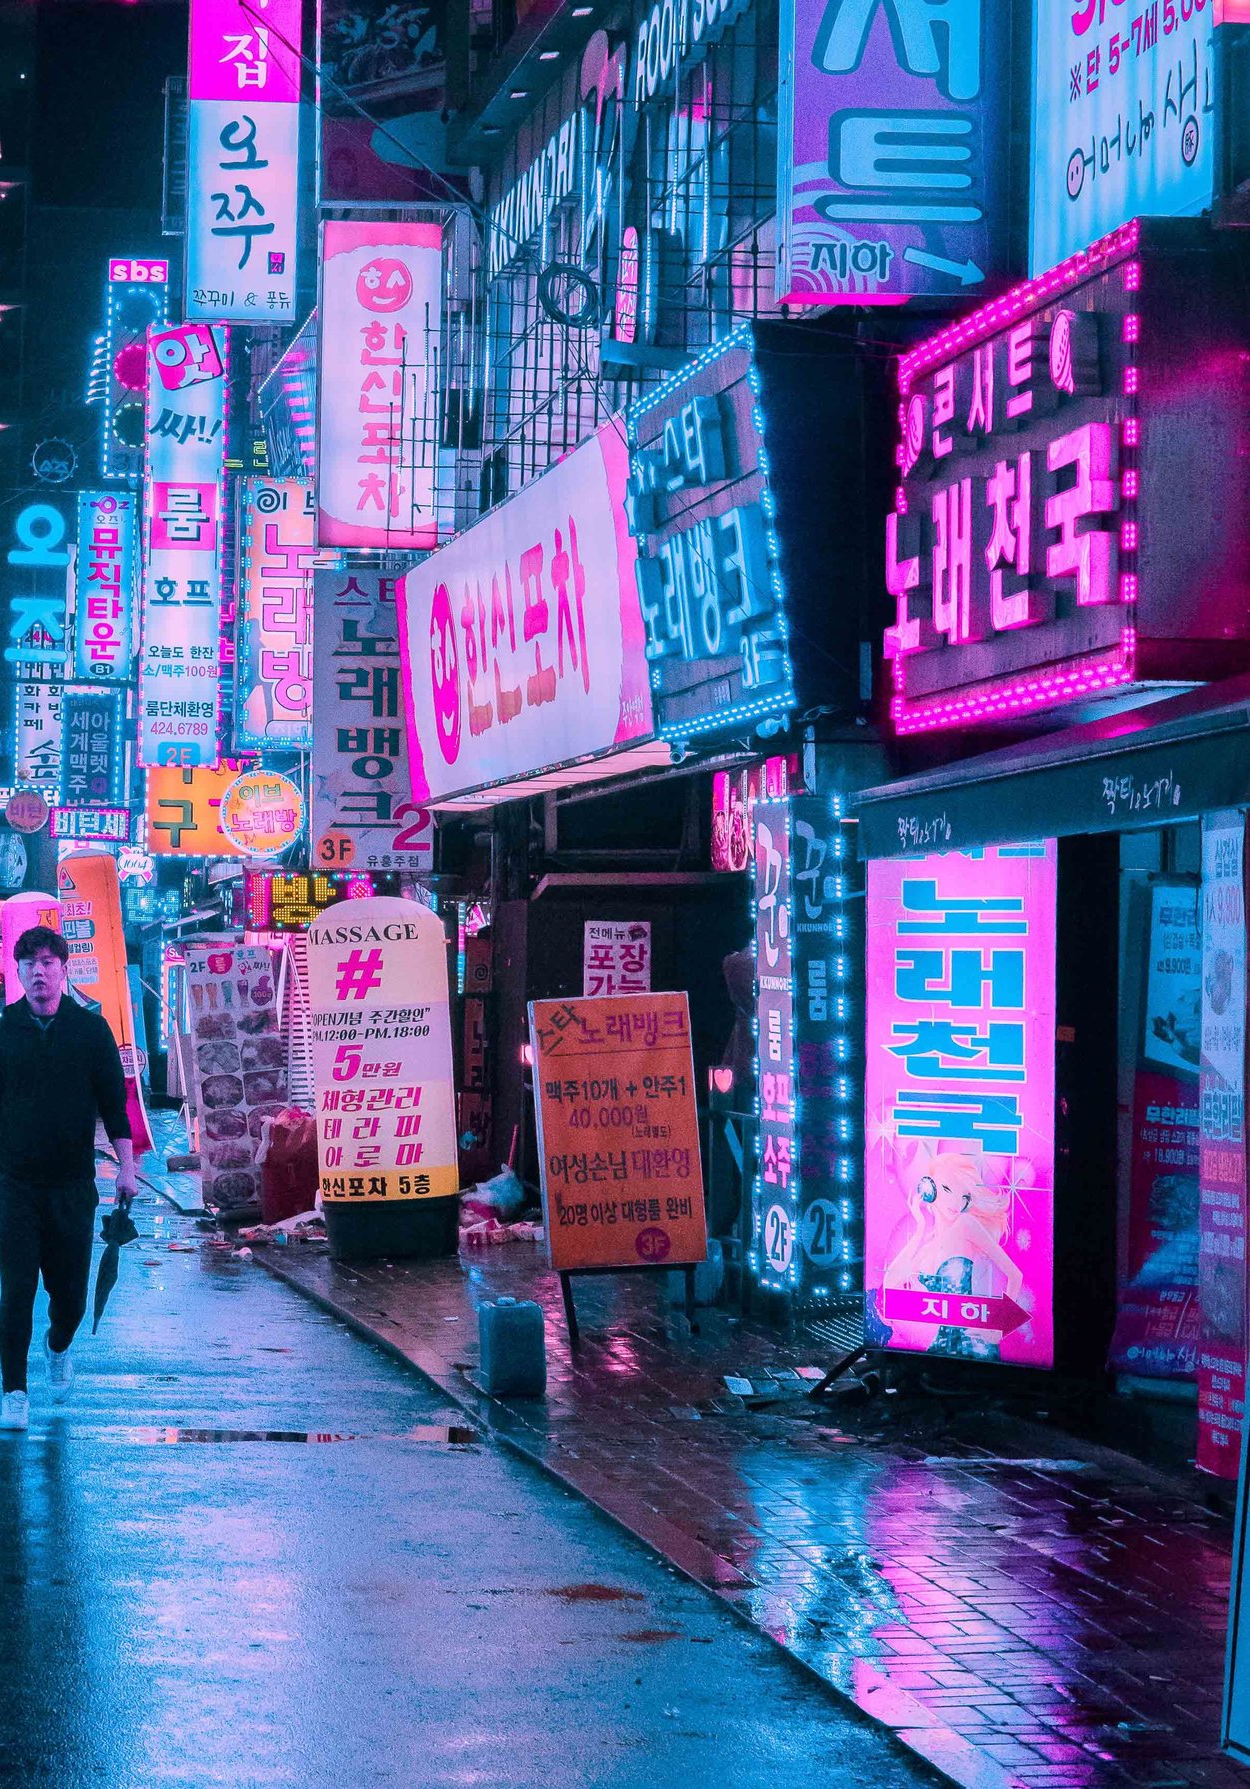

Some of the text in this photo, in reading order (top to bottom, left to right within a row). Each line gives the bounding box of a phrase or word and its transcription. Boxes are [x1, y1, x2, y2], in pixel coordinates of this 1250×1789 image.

[219, 27, 270, 89] 집
[113, 260, 164, 282] sbs
[811, 241, 892, 284] 지하
[154, 333, 215, 388] 앗
[932, 320, 1034, 460] 콘서트
[357, 322, 405, 514] 한신포차
[158, 487, 211, 541] 룸
[884, 422, 1106, 660] 노래천국
[4, 504, 70, 664] 오즈
[85, 527, 124, 661] 뮤직타운
[149, 576, 215, 607] 호프
[636, 506, 752, 662] 노래뱅크
[261, 523, 318, 711] 노래방
[461, 515, 591, 737] 한신포차
[94, 664, 111, 674] B1
[147, 645, 215, 659] 오늘도 한잔
[145, 700, 215, 718] 룸단체환영
[330, 618, 403, 829] 노래뱅크
[90, 711, 111, 775] 아울렛
[150, 721, 209, 736] 424.6789
[68, 711, 91, 795] 세계맥주
[165, 747, 193, 765] 2F
[238, 784, 285, 809] 이브
[231, 808, 298, 834] 노래방
[392, 803, 432, 851] 2
[320, 838, 352, 861] 3F
[366, 854, 420, 868] 유흥주점
[309, 923, 419, 947] MASSAGE
[588, 926, 626, 940] 전메뉴
[190, 962, 207, 973] 2F
[587, 943, 649, 973] 포장
[578, 1010, 690, 1046] 노래뱅크
[881, 877, 1030, 1157] 노래천국
[768, 1009, 782, 1062] 룸
[321, 1086, 423, 1113] 체형관리
[545, 1077, 618, 1104] 맥주10개
[643, 1075, 686, 1099] 안주1
[568, 1104, 649, 1130] 40,000원
[550, 1147, 692, 1184] 여성손님 대환영
[763, 1134, 791, 1189] 소주
[321, 1174, 431, 1199] 한신포차 5층
[558, 1204, 588, 1228] 20명
[590, 1202, 618, 1225] 이상
[666, 1197, 693, 1222] 완비
[809, 1204, 836, 1256] 2F
[769, 1210, 788, 1262] 2F
[920, 1297, 991, 1324] 지하
